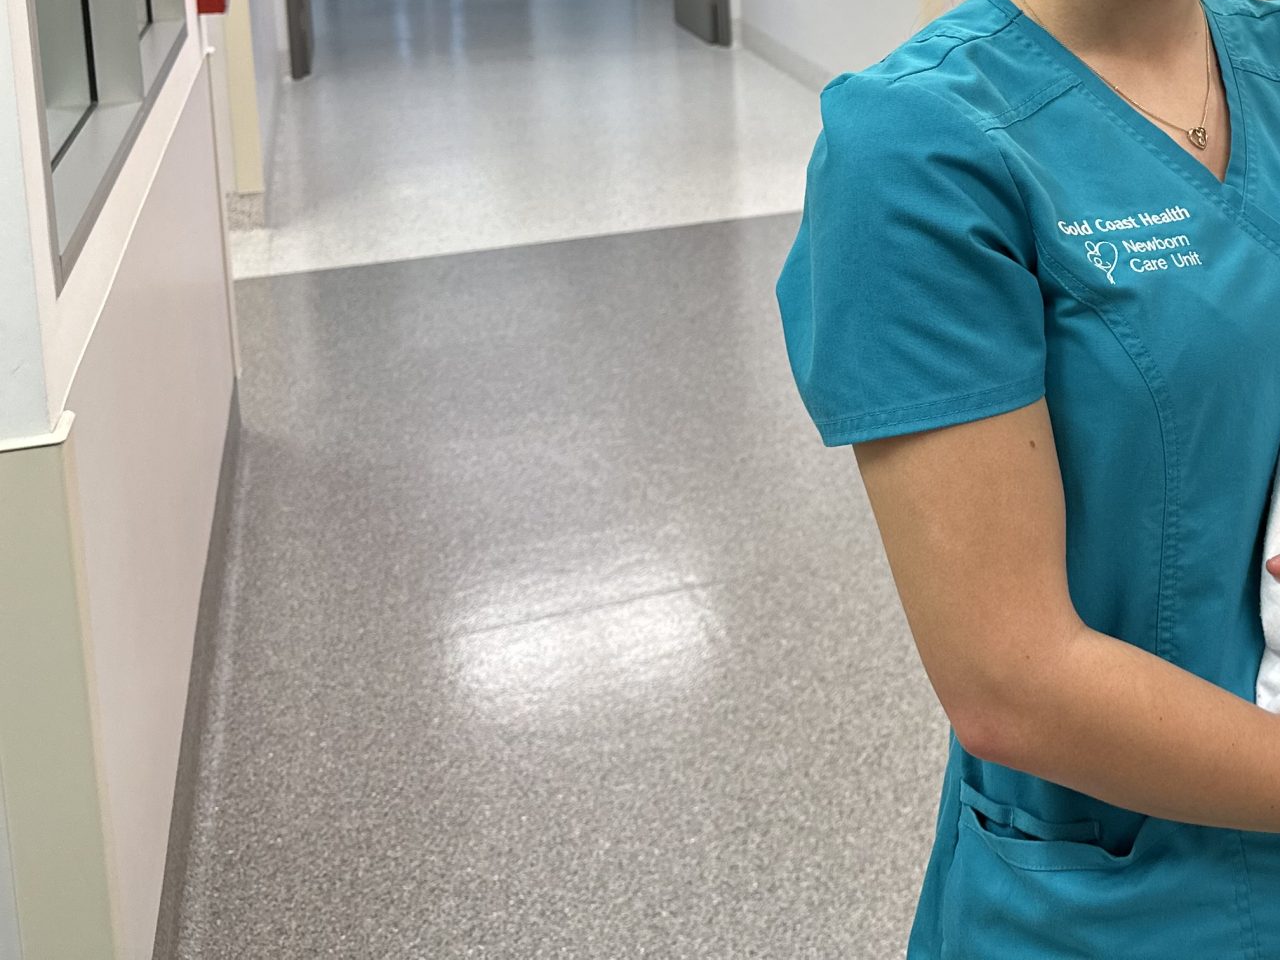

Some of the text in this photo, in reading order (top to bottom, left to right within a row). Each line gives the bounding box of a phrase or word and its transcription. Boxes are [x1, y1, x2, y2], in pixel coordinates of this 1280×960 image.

[1057, 205, 1190, 235] Gold Coast Health
[1122, 235, 1190, 253] Newborn
[1129, 251, 1202, 273] Care Unit
